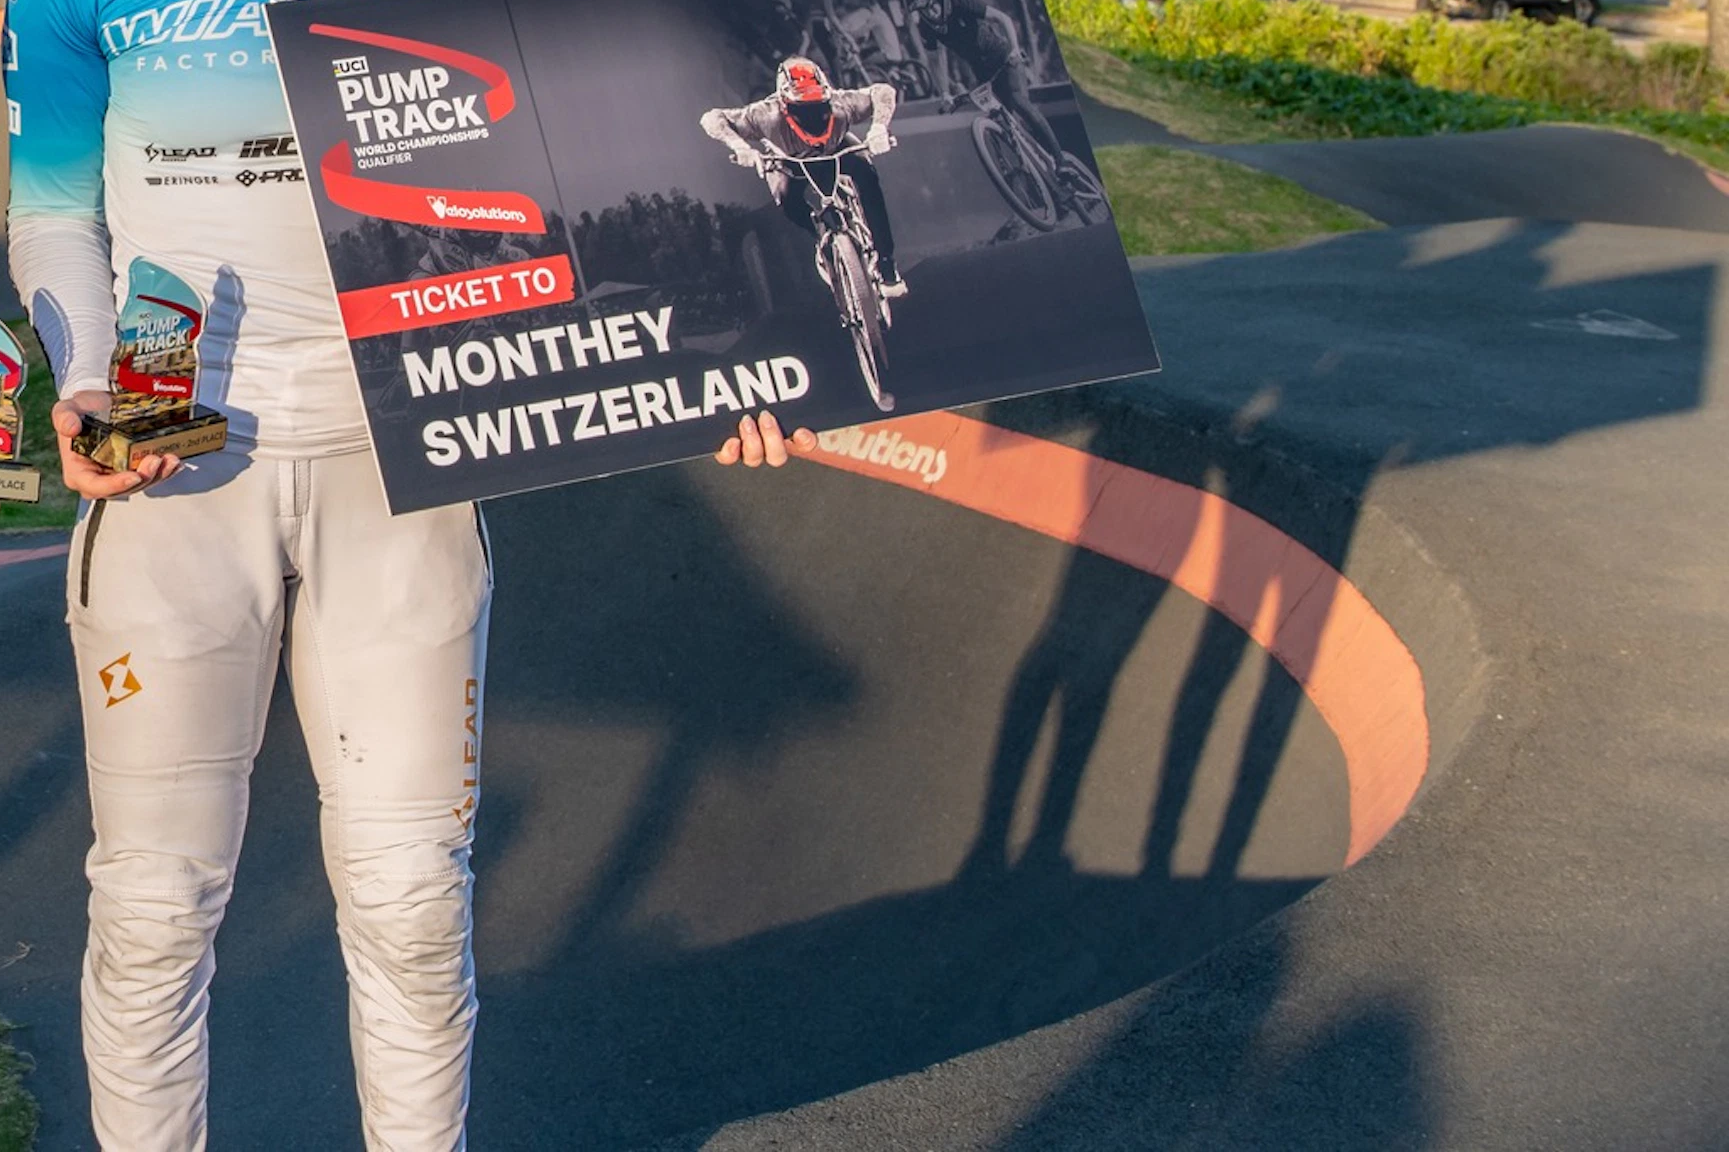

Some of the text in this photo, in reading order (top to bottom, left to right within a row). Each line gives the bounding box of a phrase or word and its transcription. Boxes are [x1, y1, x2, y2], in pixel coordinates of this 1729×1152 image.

[136, 51, 275, 71] FACTOR
[339, 60, 366, 74] UCI
[337, 66, 450, 112] PUMP
[346, 94, 485, 144] TRACK
[354, 127, 490, 158] WORLD CHAMPIONSHIPS
[357, 153, 413, 170] QUALIFIER
[425, 195, 527, 224] Velosolutions
[390, 267, 556, 319] TICKET TO
[136, 315, 180, 338] PUMP
[136, 328, 188, 355] TRACK
[403, 306, 674, 398] MONTHEY
[421, 355, 811, 468] SWITZERLAND
